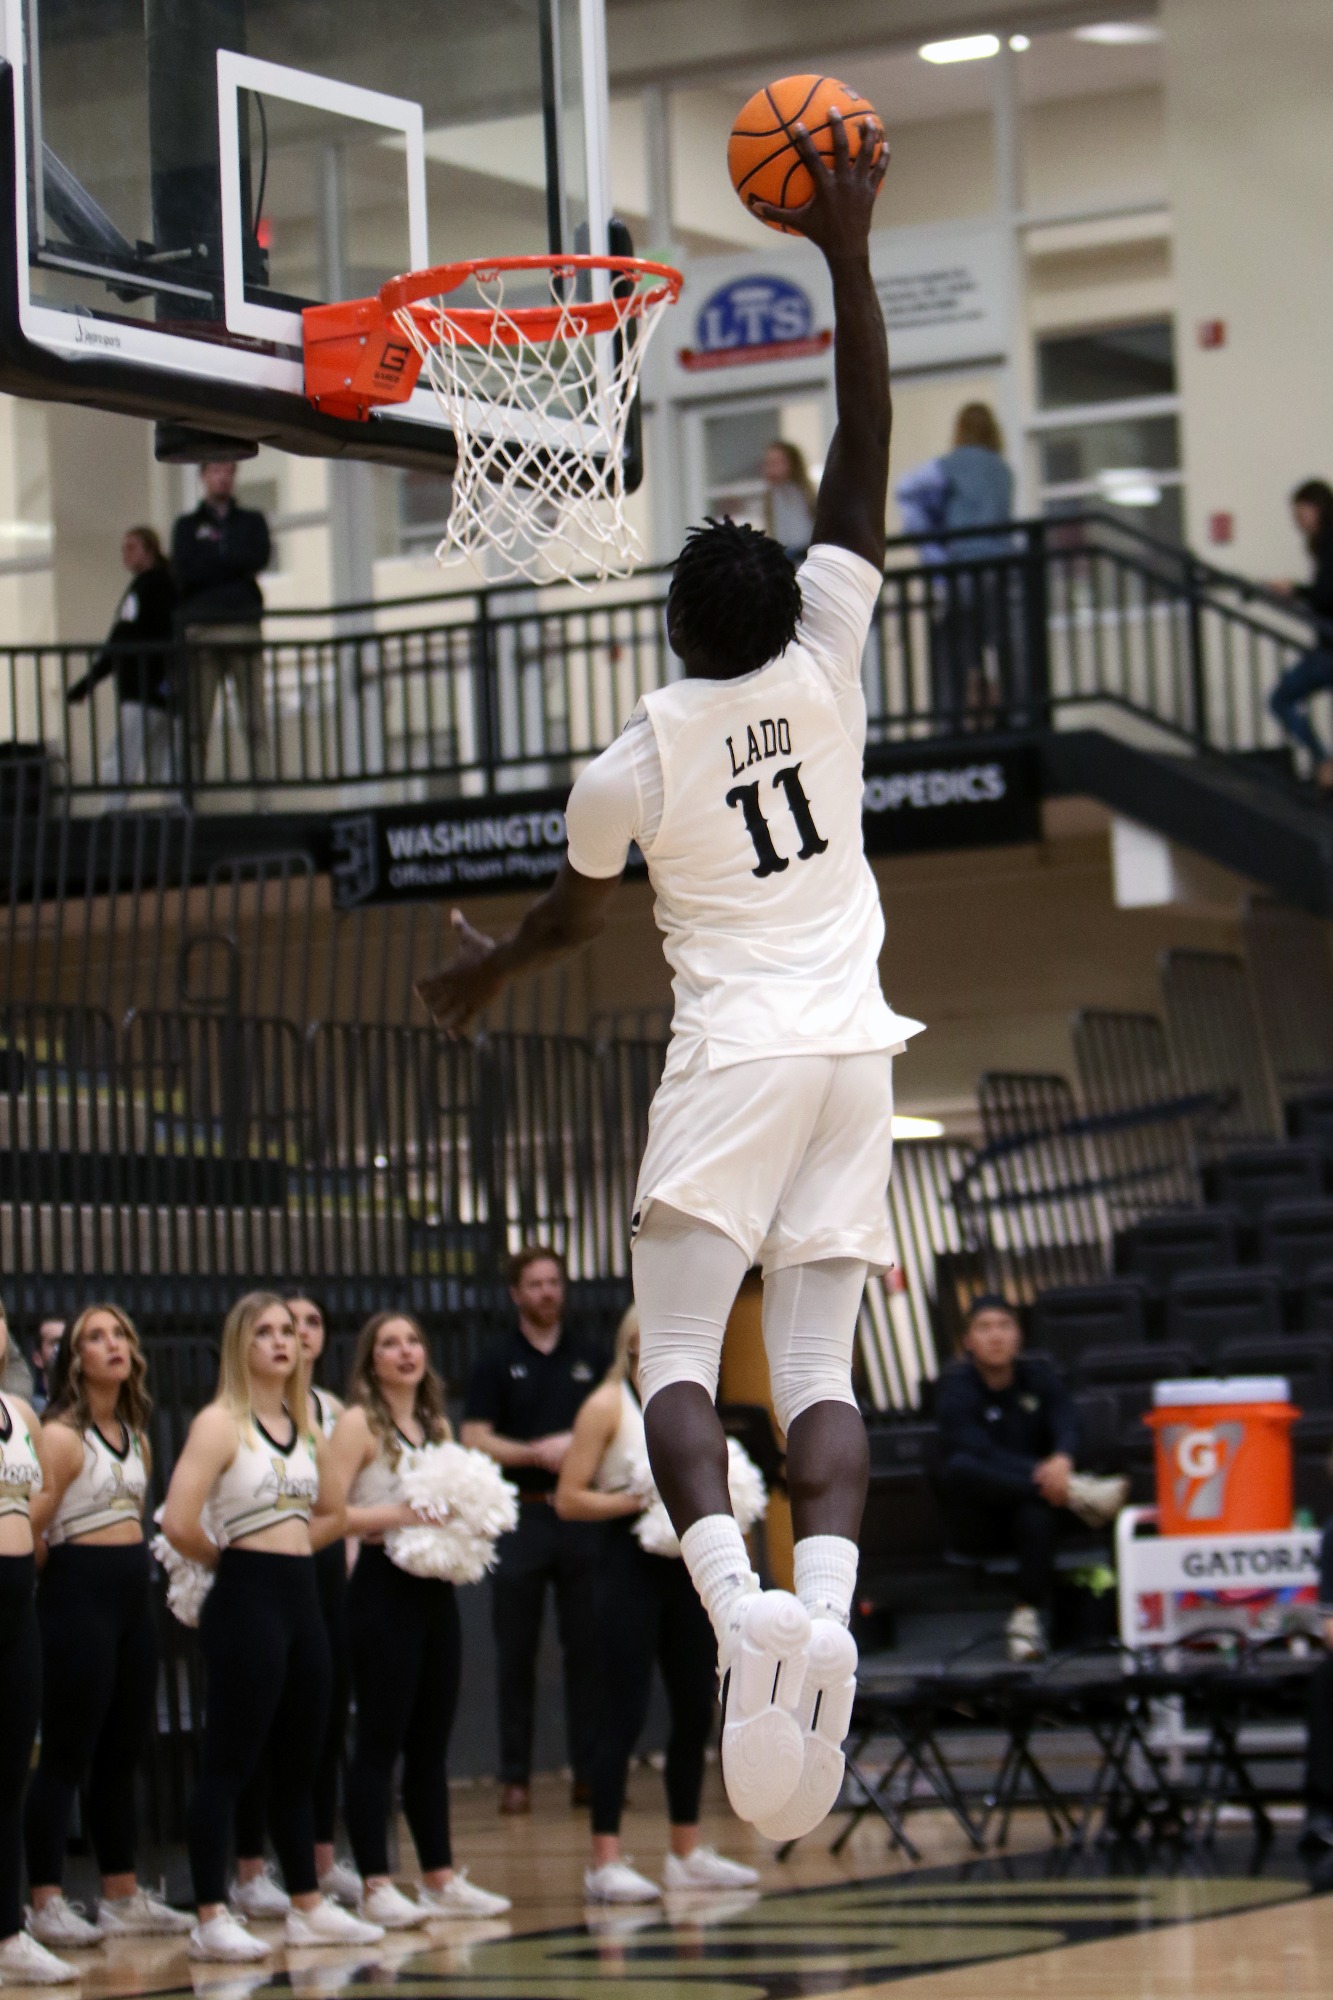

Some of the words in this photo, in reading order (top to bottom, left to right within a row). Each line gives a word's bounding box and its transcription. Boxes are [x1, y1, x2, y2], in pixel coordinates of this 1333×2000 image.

[704, 297, 806, 350] LTS
[726, 718, 792, 778] LADO
[386, 810, 567, 859] WASHINGTO
[726, 762, 829, 878] 11
[389, 861, 453, 888] Official
[456, 857, 503, 881] Team
[1177, 1431, 1217, 1478] G
